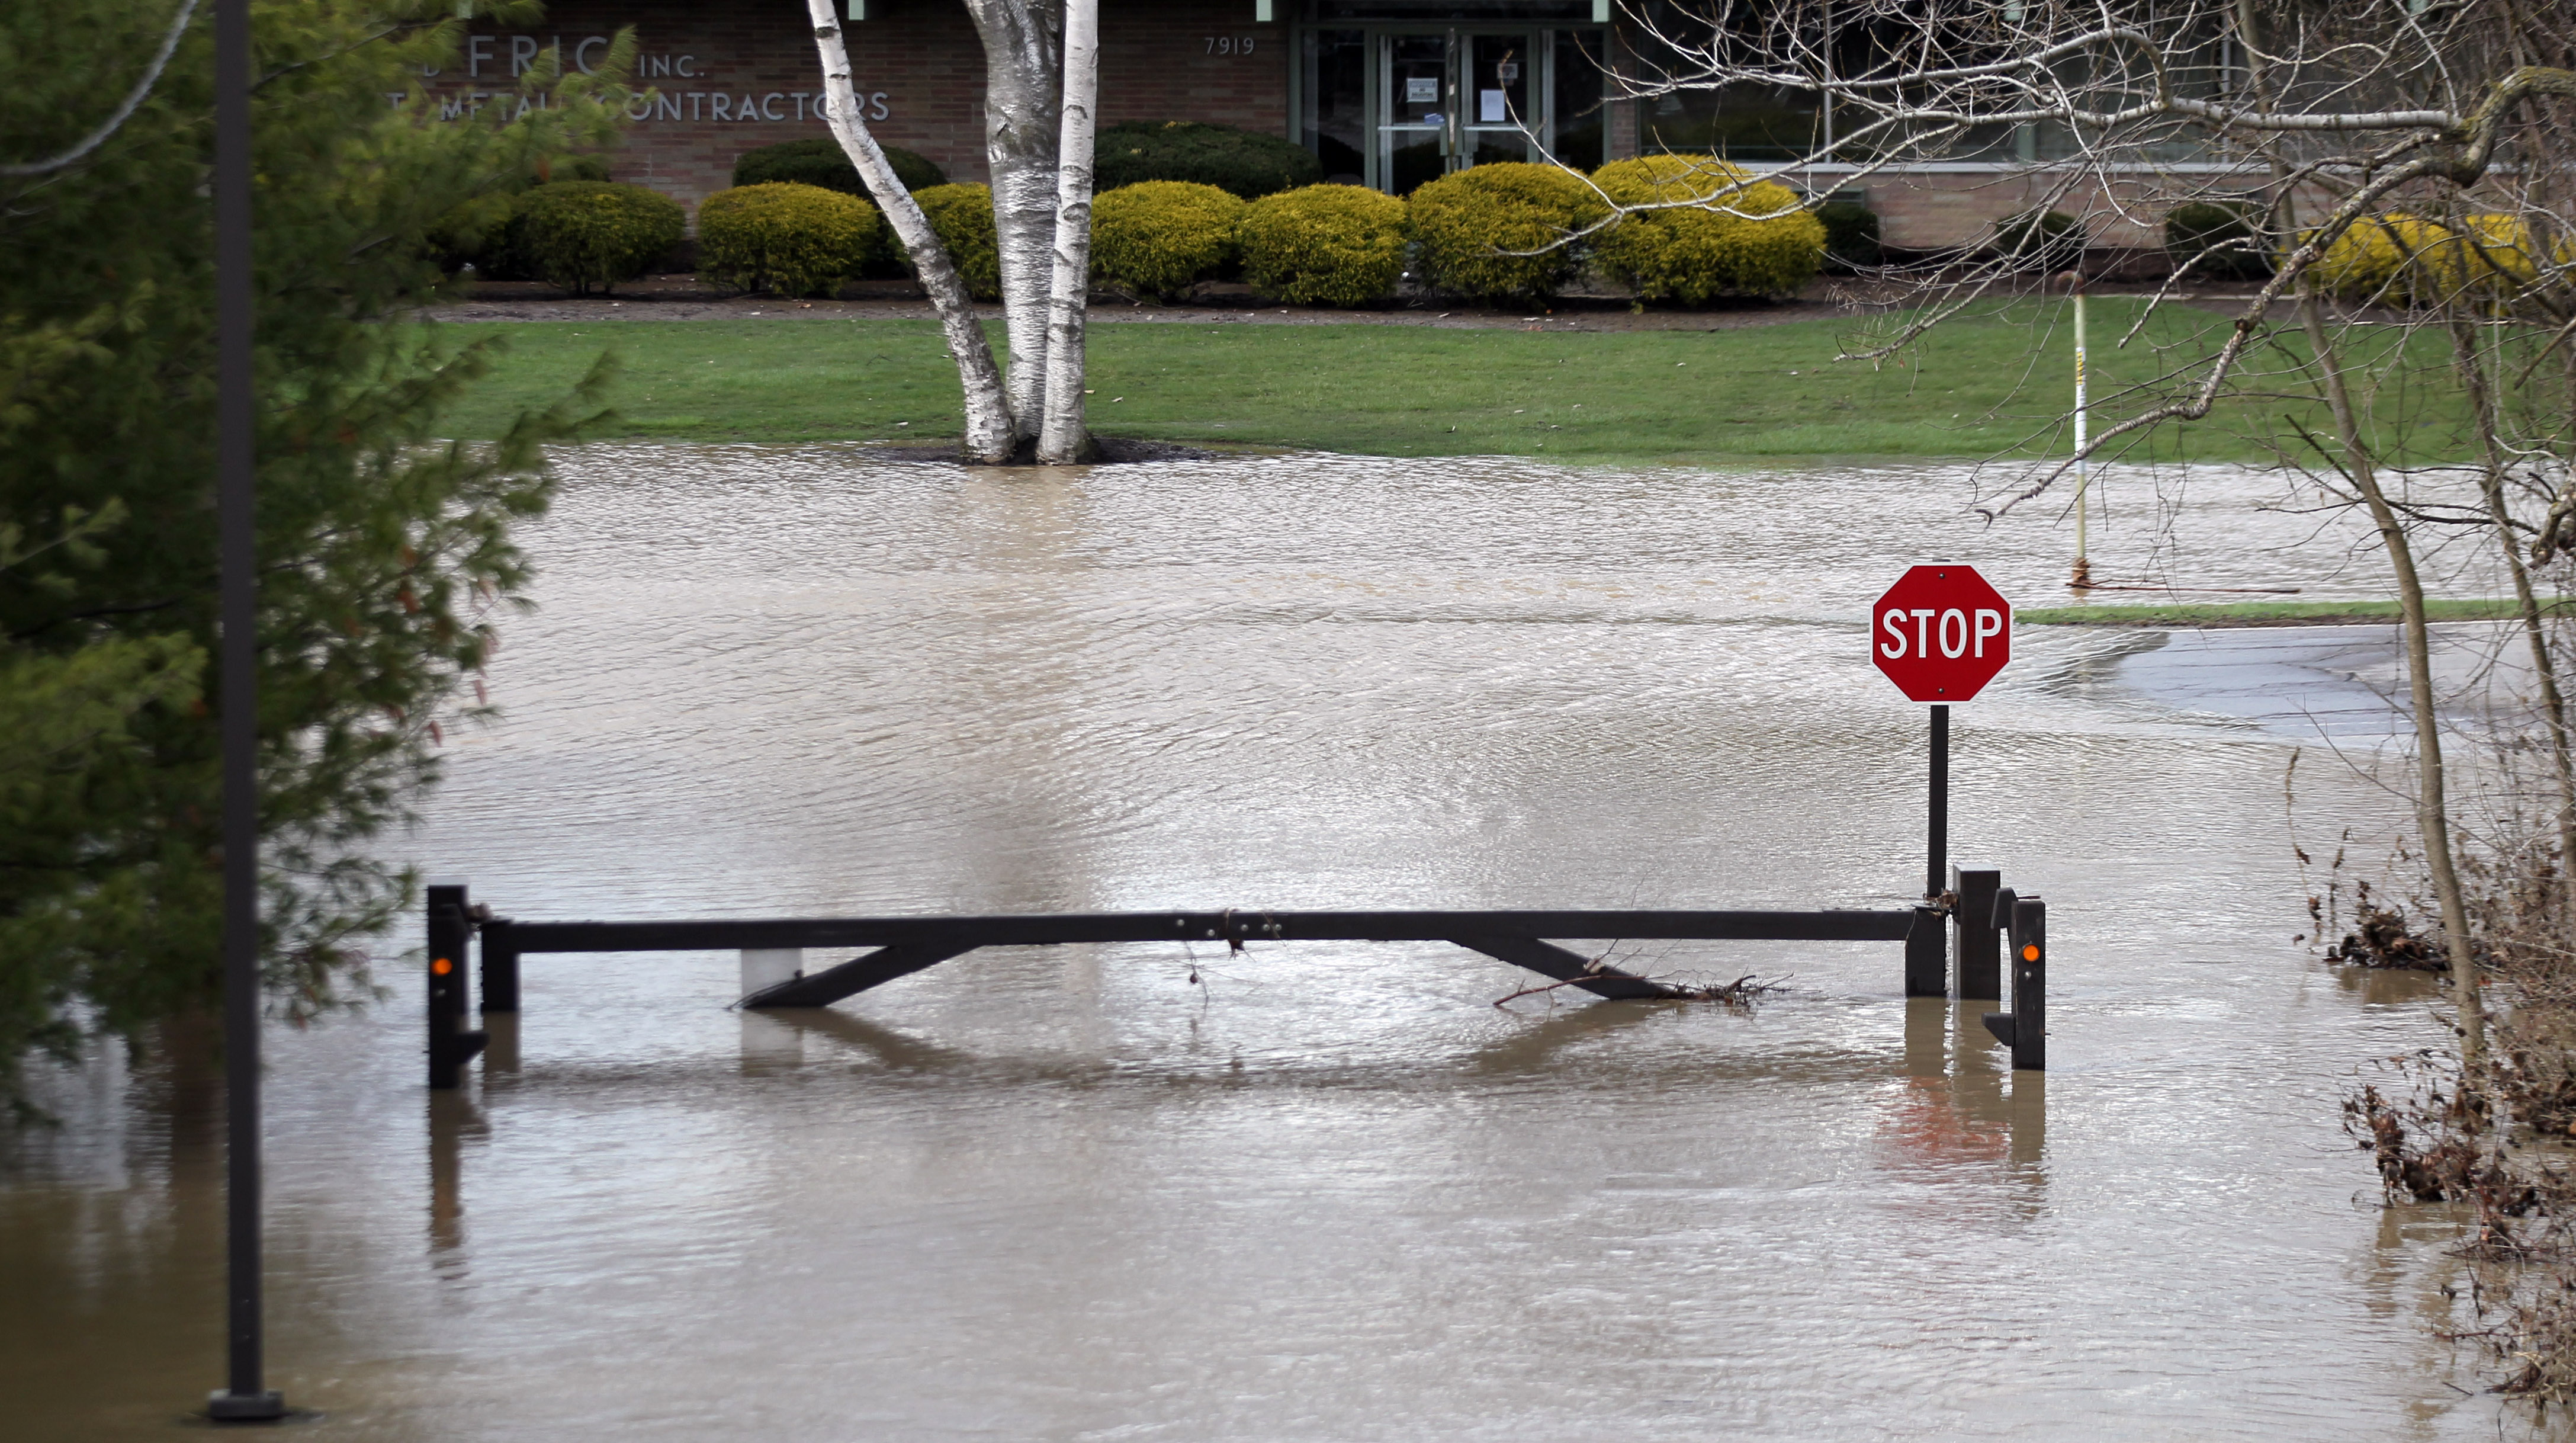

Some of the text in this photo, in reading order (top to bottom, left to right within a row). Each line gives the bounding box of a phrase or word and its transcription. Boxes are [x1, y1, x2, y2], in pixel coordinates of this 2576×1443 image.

[470, 36, 608, 78] FRIC
[640, 55, 705, 78] INC.
[1205, 37, 1254, 54] 7919
[595, 91, 889, 121] ONTRACTS
[1880, 608, 2003, 659] STOP
